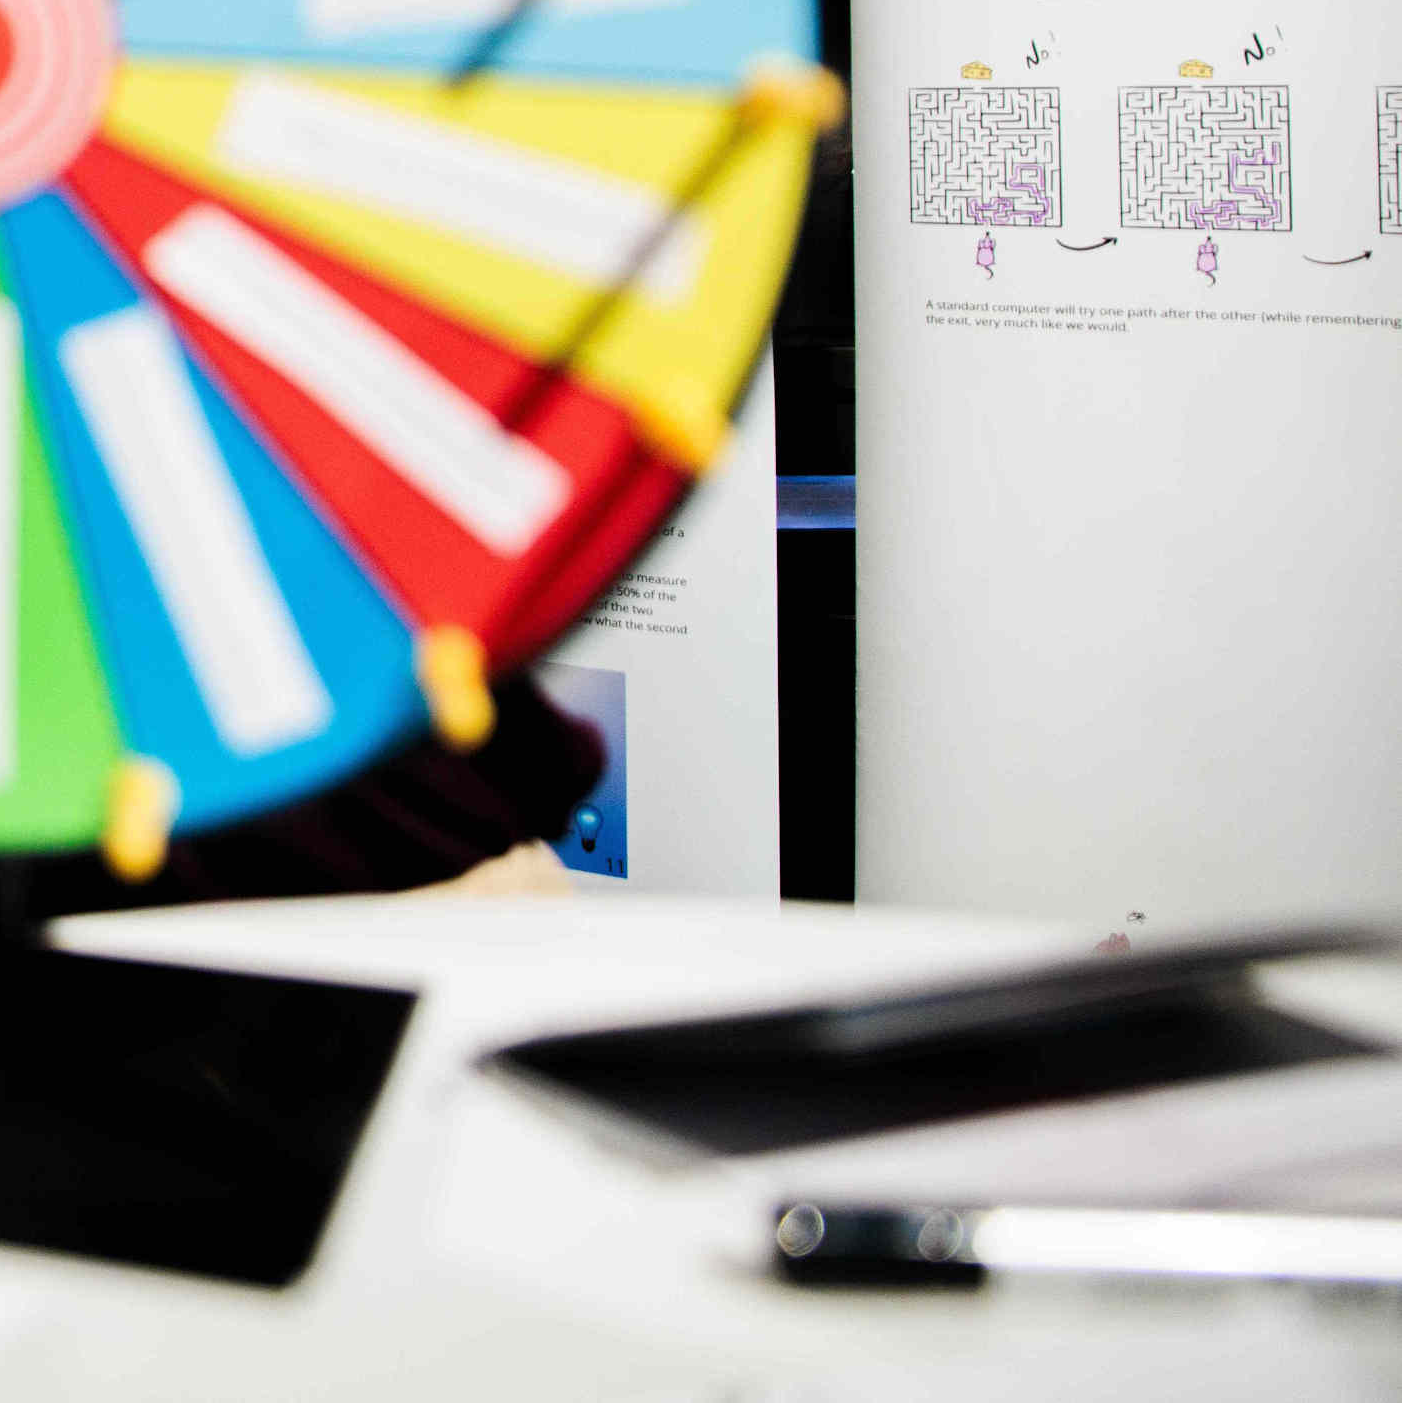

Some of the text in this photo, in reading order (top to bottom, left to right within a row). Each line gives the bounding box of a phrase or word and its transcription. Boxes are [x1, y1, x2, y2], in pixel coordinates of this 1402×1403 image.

[925, 299, 934, 310] A
[935, 300, 988, 312] standard
[991, 303, 1051, 317] computer
[1054, 304, 1075, 316] will
[1079, 305, 1096, 319] try
[1099, 308, 1124, 317] one
[1127, 307, 1157, 321] path
[1161, 306, 1191, 319] after
[1195, 309, 1217, 320] the
[1221, 309, 1256, 322] other
[1261, 311, 1302, 325] (while
[925, 314, 946, 326] the
[975, 318, 999, 330] very
[1004, 317, 1038, 329] much
[1041, 319, 1062, 330] like
[1065, 322, 1084, 331] we
[662, 526, 684, 537] of a
[637, 574, 687, 586] measure
[617, 588, 677, 602] 50% of the
[611, 602, 629, 613] the
[632, 606, 653, 615] two
[595, 617, 621, 628] what
[625, 620, 643, 630] the
[647, 624, 688, 635] second
